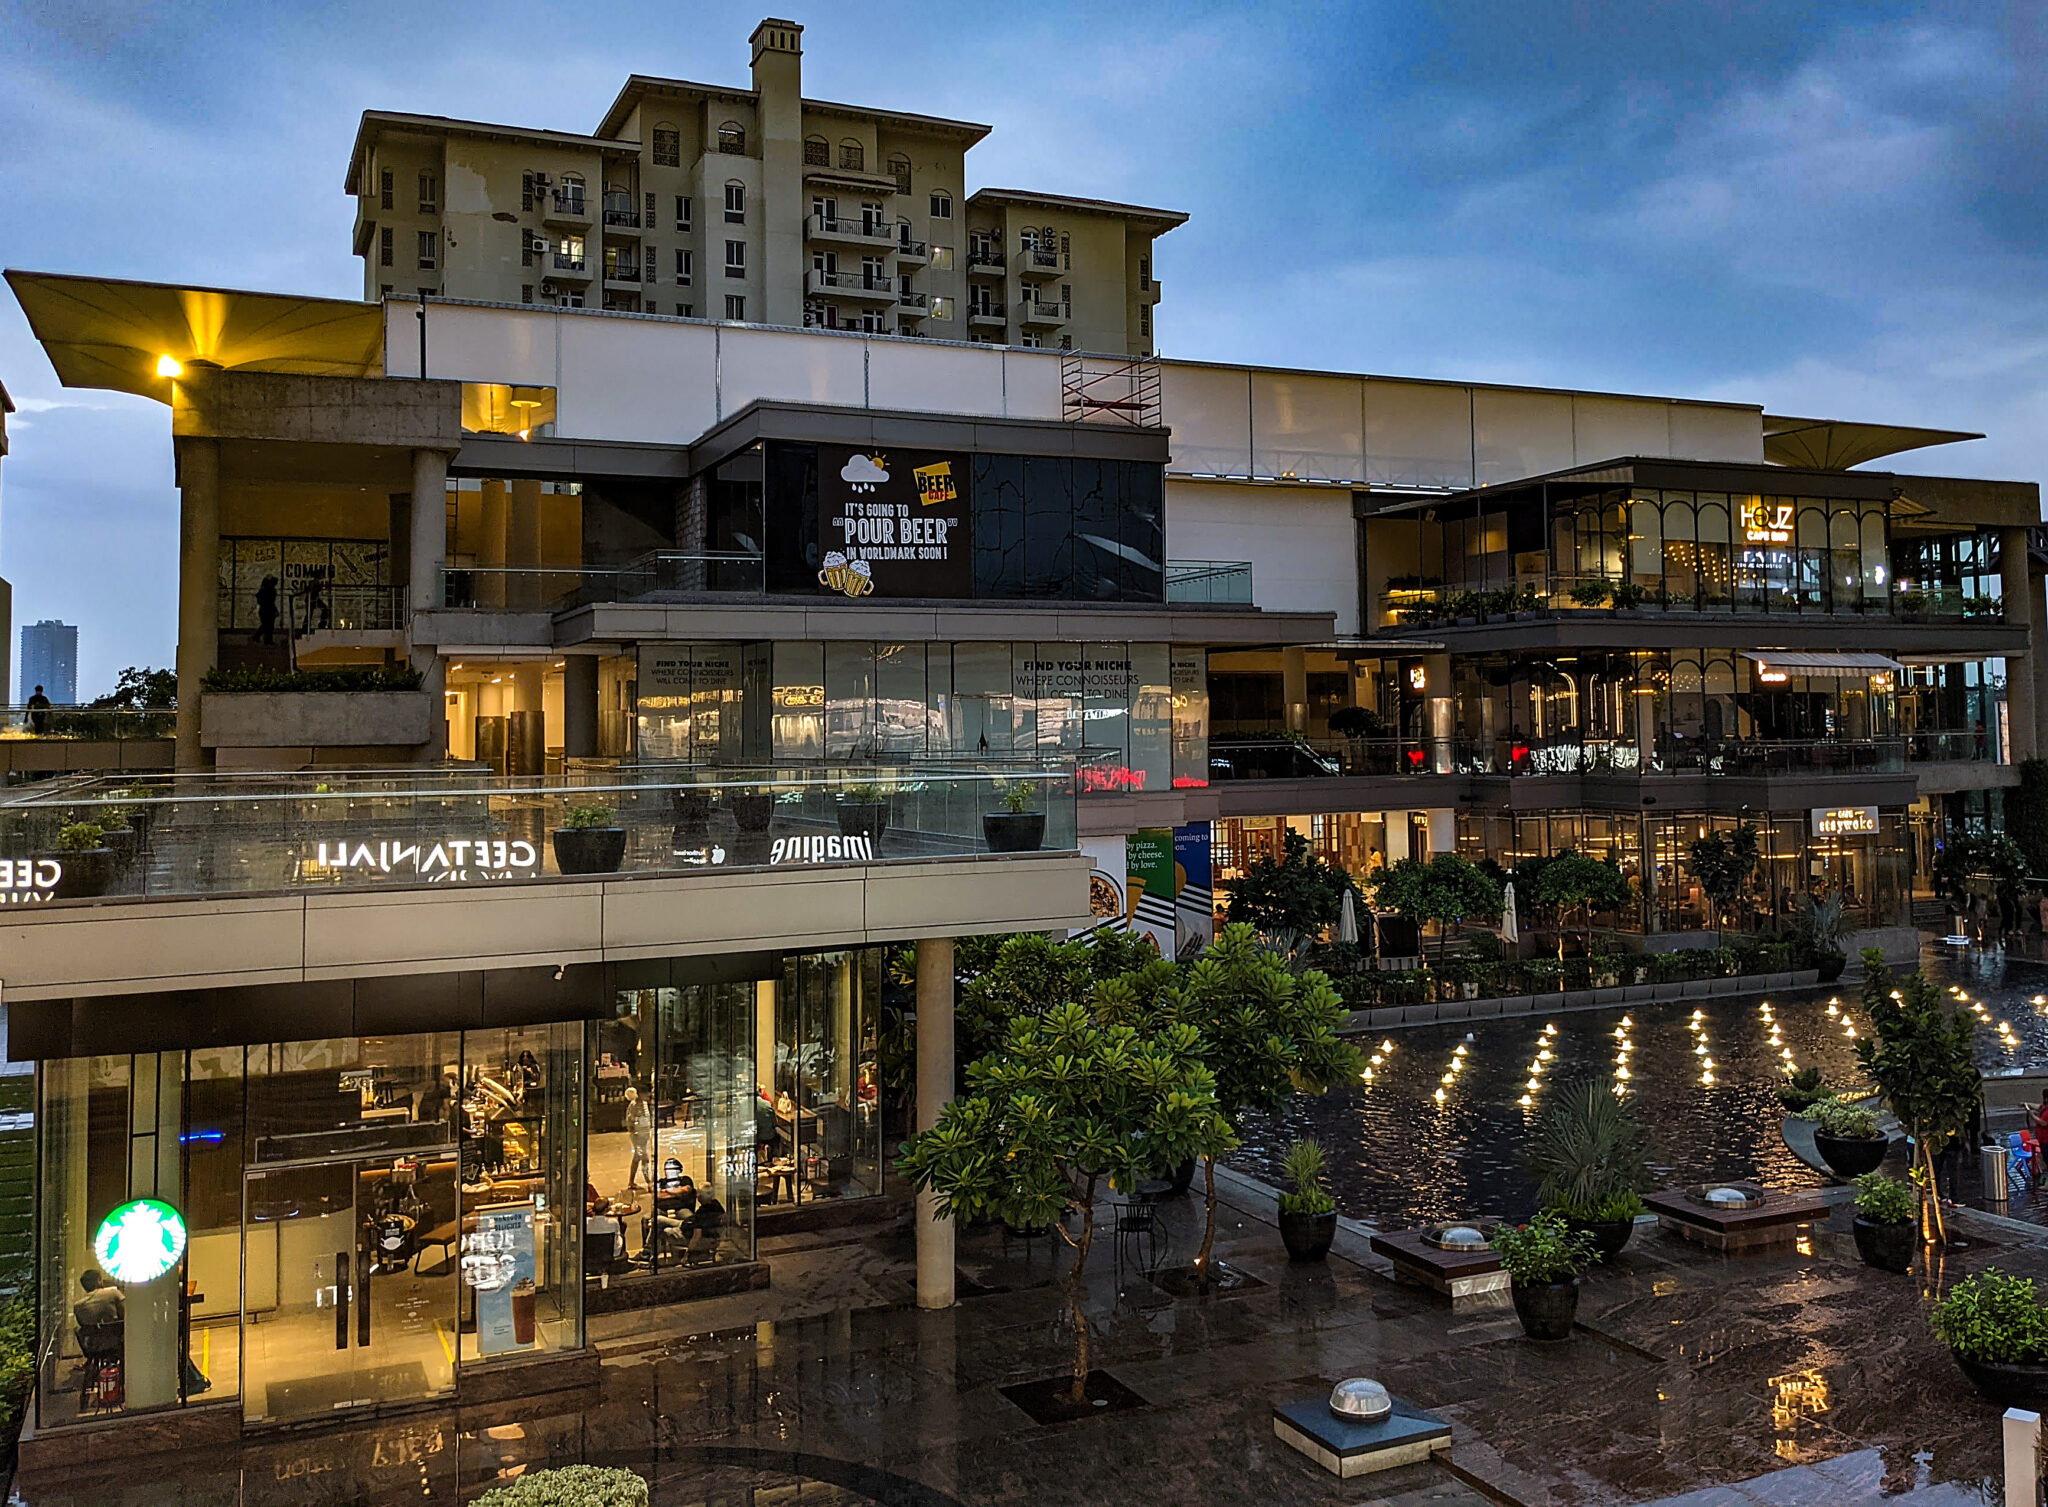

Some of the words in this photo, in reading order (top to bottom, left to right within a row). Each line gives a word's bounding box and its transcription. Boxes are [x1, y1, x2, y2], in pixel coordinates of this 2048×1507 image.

[917, 474, 955, 494] BEER
[928, 490, 950, 501] CAFE
[845, 502, 864, 517] IT'S
[866, 503, 895, 517] GOING
[896, 504, 909, 517] TO
[846, 546, 857, 560] IN
[858, 546, 917, 560] WORLDMARK
[918, 546, 942, 560] SOON
[679, 660, 702, 668] YOUR
[705, 660, 729, 668] NICHE
[1023, 661, 1053, 671] FIND
[1058, 661, 1092, 671] YOUR
[1095, 660, 1132, 671] NICHE
[1015, 675, 1053, 686] WHERE
[1055, 675, 1139, 686] CONNOISSEURS
[1819, 815, 1874, 835] staywoke
[1174, 833, 1201, 843] coming
[1201, 833, 1209, 841] to
[1135, 840, 1158, 852] pizza.
[1128, 851, 1138, 861] by
[1138, 851, 1165, 860] cheese.
[1131, 861, 1140, 871] by
[1140, 860, 1158, 869] love.
